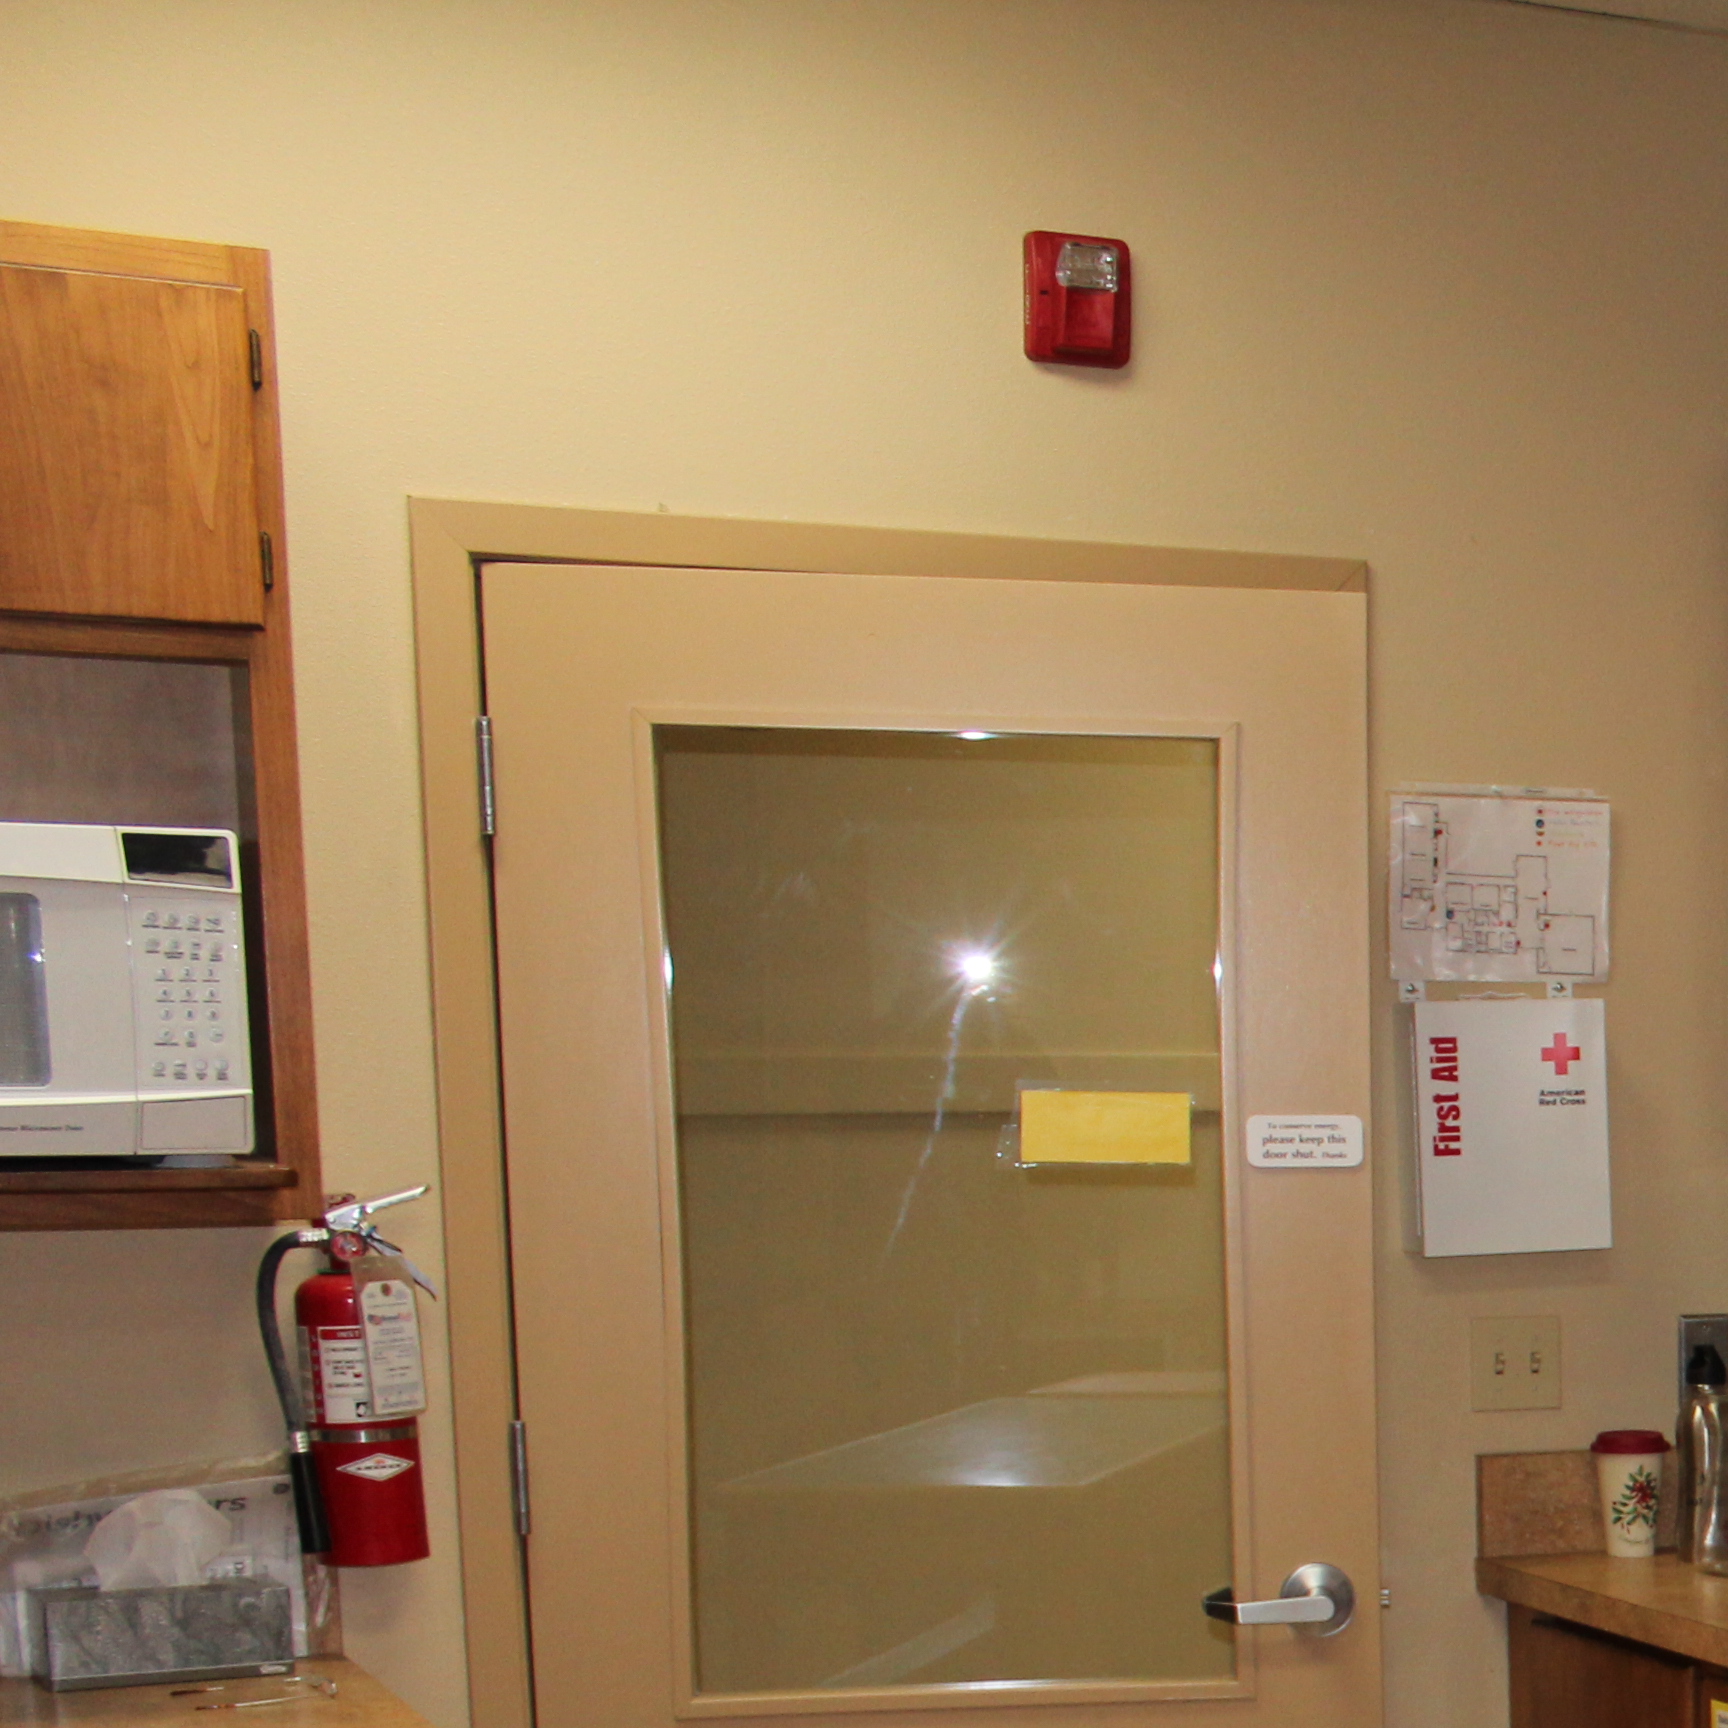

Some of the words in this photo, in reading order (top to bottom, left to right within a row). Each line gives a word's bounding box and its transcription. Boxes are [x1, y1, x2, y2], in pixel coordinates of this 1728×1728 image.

[1429, 1036, 1459, 1083] Aid
[1560, 1097, 1586, 1105] Cross
[1433, 1092, 1462, 1157] First
[1262, 1134, 1296, 1147] please
[1298, 1134, 1325, 1147] keep
[1327, 1134, 1347, 1143] this
[1262, 1149, 1288, 1158] door
